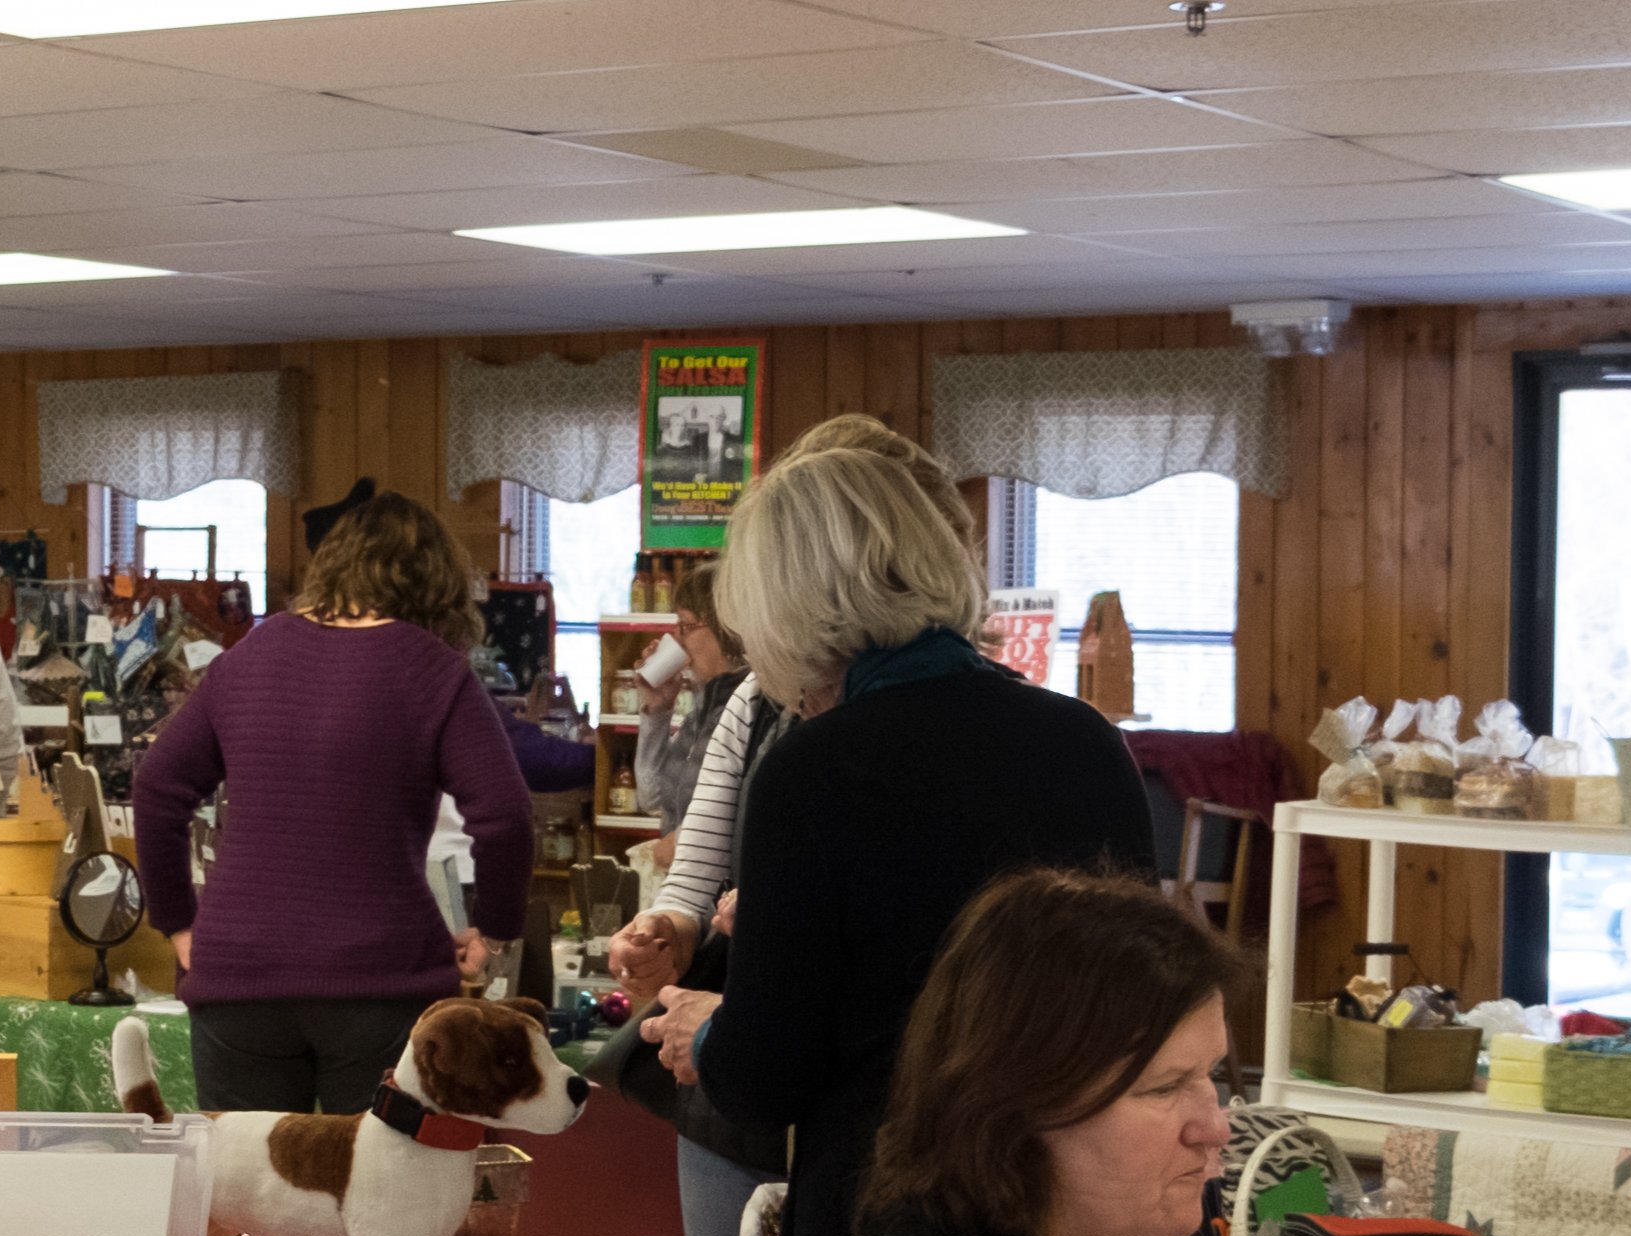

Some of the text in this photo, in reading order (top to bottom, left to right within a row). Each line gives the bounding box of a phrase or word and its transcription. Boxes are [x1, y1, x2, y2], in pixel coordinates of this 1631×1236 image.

[659, 354, 748, 369] To Get Our
[658, 367, 747, 386] SALSA
[1022, 596, 1054, 611] Match
